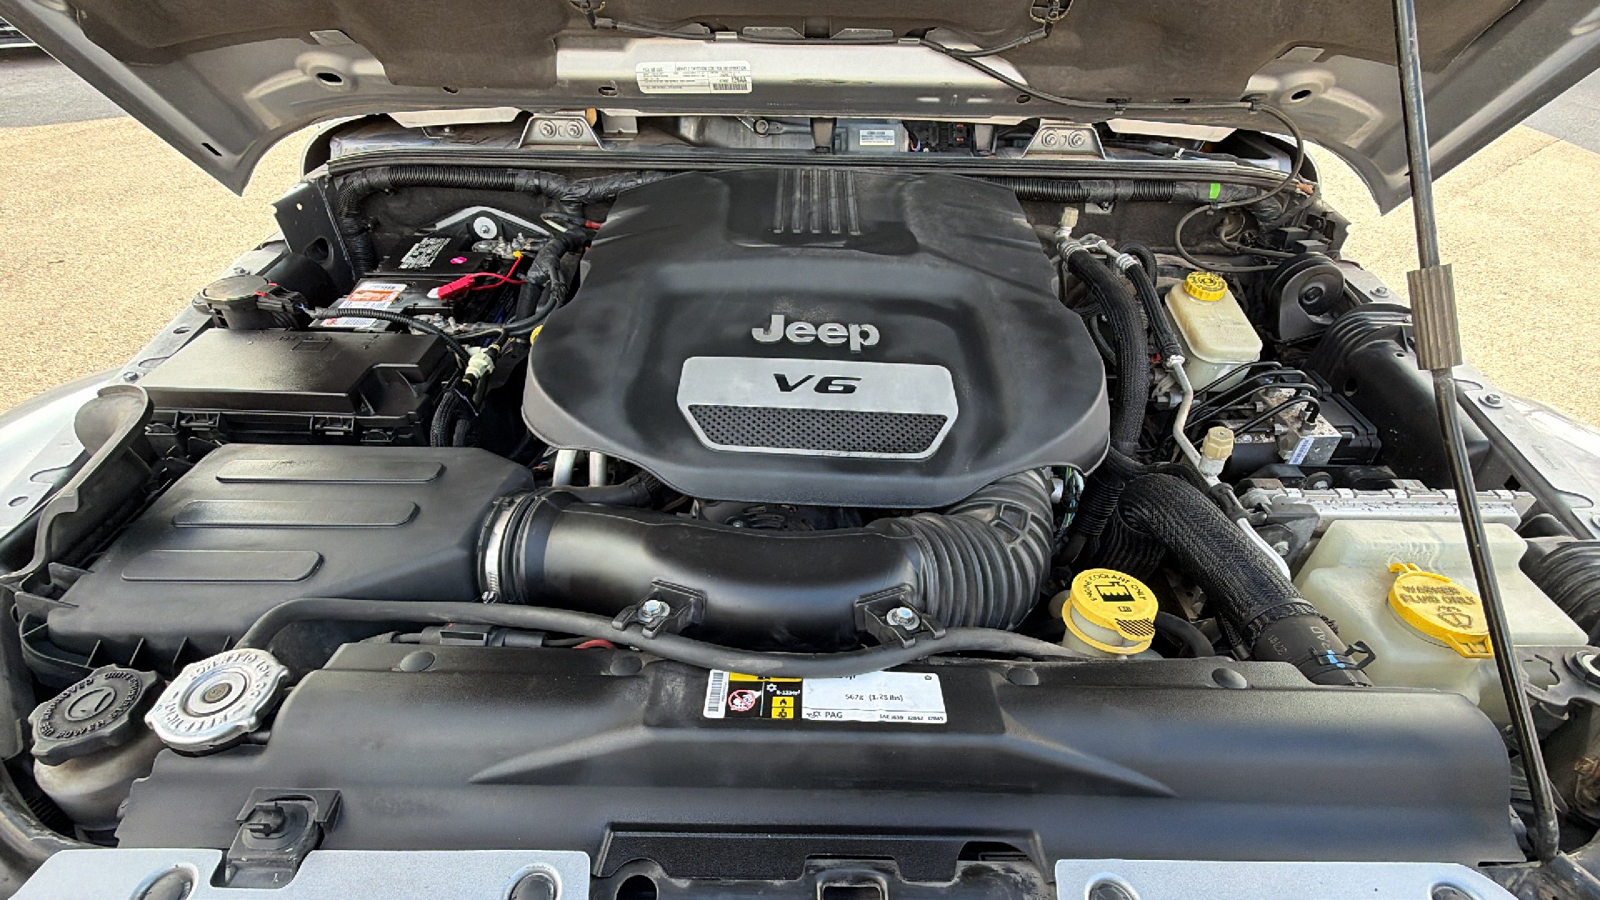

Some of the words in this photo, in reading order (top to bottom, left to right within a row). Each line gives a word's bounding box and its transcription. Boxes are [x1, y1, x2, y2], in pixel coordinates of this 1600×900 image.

[751, 314, 880, 353] Jeep
[773, 373, 862, 394] V6
[1089, 573, 1131, 584] COOLANT
[1130, 584, 1147, 601] ONLY
[1399, 594, 1441, 604] FLUID
[825, 711, 843, 719] PAG
[41, 721, 56, 737] USE
[56, 719, 106, 739] POWER
